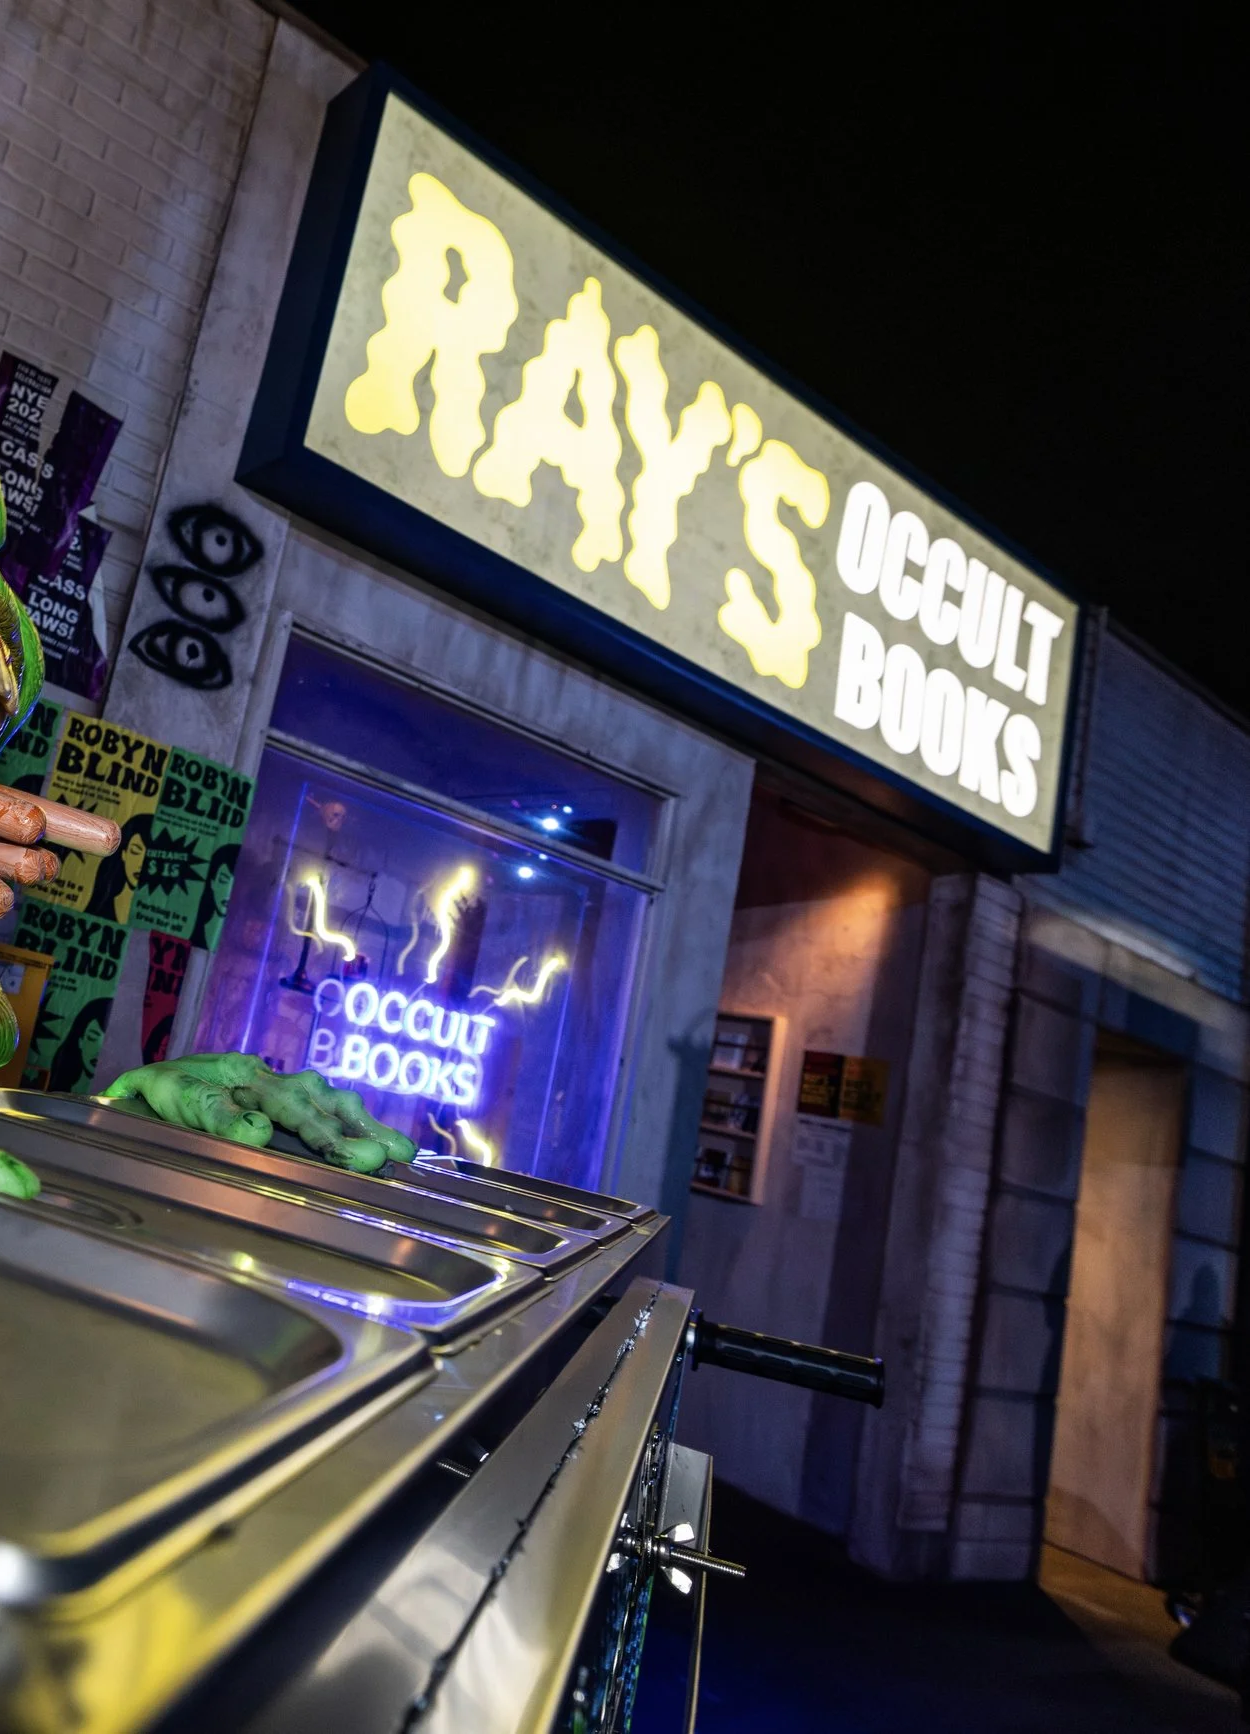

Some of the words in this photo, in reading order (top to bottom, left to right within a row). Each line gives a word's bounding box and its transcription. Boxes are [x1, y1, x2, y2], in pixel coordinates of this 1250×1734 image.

[6, 397, 43, 424] 202
[10, 381, 49, 410] NYE
[344, 171, 831, 689] RAY'S
[1, 483, 39, 517] WS!
[28, 591, 79, 625] LONG
[835, 481, 1065, 706] OCCULT
[833, 611, 1041, 818] BOOKS
[56, 741, 160, 798] BLIND
[68, 717, 168, 777] ROBYN
[170, 753, 252, 809] ROBYN
[22, 902, 127, 960] ROBYN
[344, 982, 496, 1056] OCCULT
[341, 1033, 478, 1106] BOOKS
